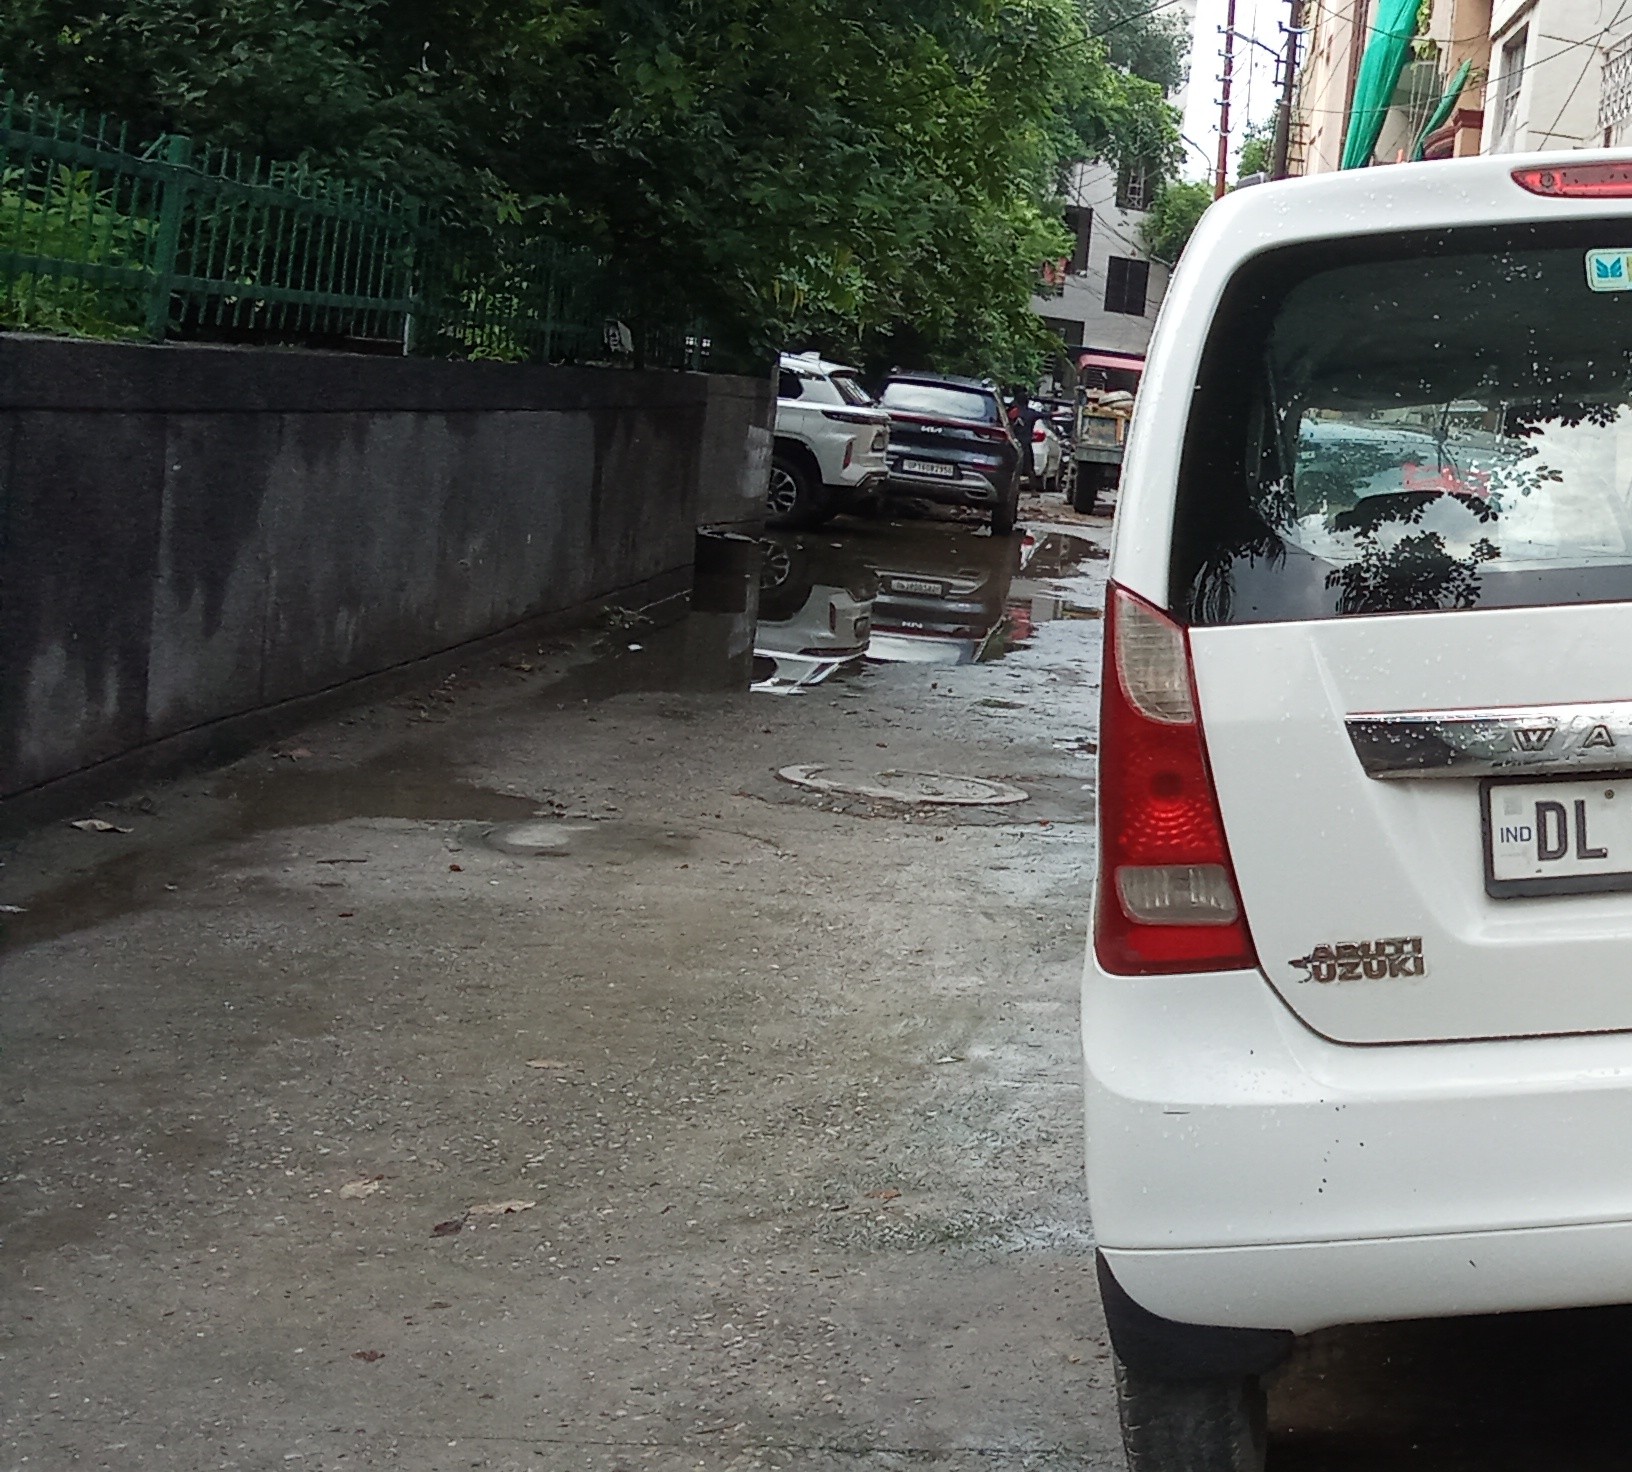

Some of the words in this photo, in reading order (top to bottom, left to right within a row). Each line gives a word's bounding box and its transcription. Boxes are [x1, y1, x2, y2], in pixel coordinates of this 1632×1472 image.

[1500, 826, 1531, 843] IND
[1535, 799, 1608, 861] DL
[1289, 936, 1422, 965] ARUTI
